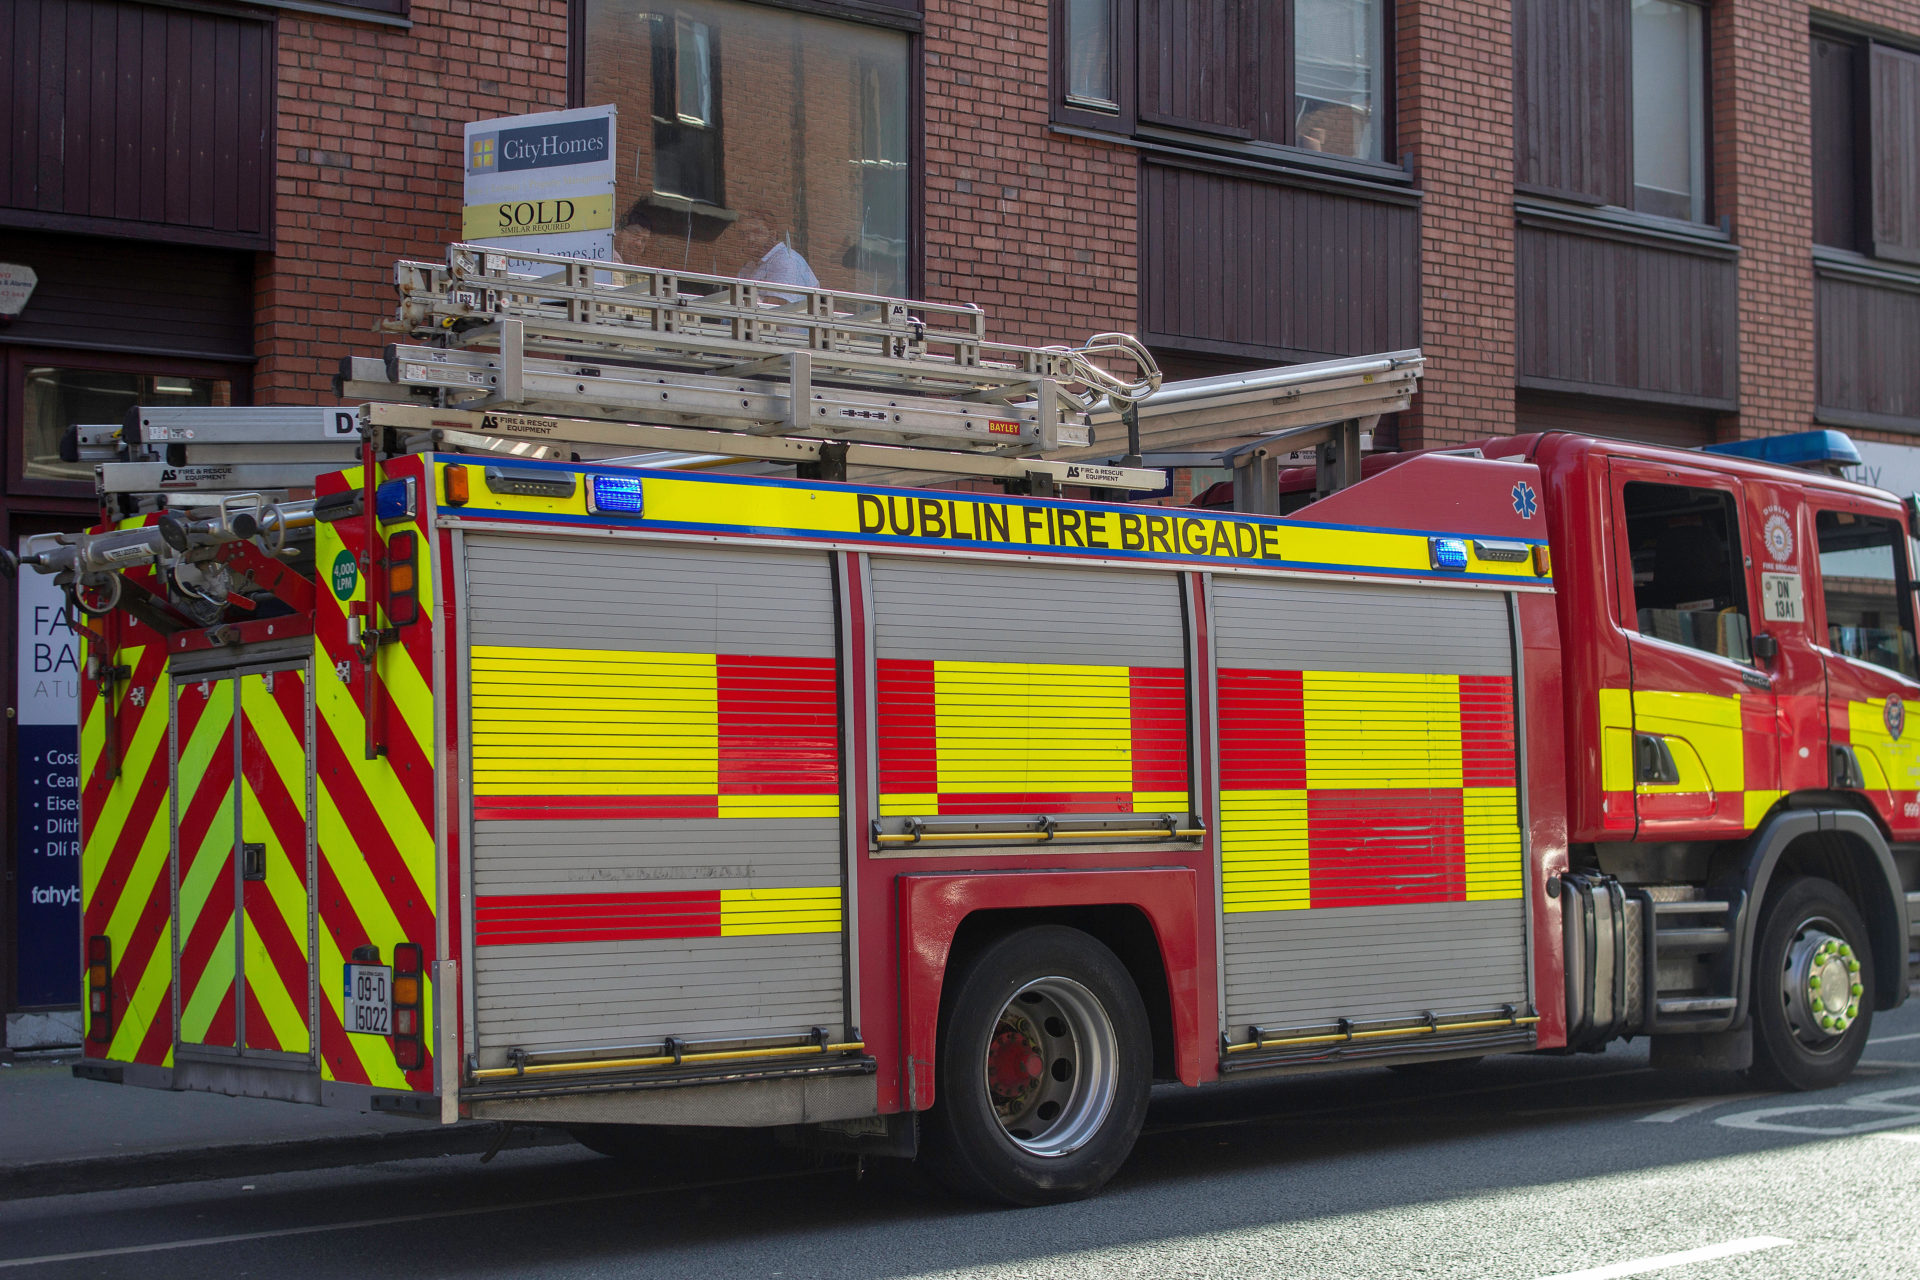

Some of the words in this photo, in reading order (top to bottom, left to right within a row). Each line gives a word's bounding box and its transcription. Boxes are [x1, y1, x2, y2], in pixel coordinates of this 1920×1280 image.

[504, 135, 604, 163] CityHomes
[499, 200, 575, 228] SOLD
[500, 224, 531, 234] SIMILAR
[532, 222, 571, 232] REQUIRED
[507, 242, 605, 271] citymes.ie
[893, 305, 903, 315] AS
[480, 415, 498, 429] AS
[500, 416, 518, 425] FIRE
[527, 419, 558, 428] RESCUE
[507, 425, 551, 434] EQUIPMENT
[989, 422, 1019, 433] BAYLEY
[161, 469, 177, 482] AS
[1067, 466, 1079, 478] AS
[1086, 474, 1118, 482] EQUIPMENT
[1763, 504, 1790, 520] DUBLIN
[856, 493, 1010, 543] DUBLIN
[1023, 506, 1109, 549] FIRE
[1119, 513, 1281, 560] BRIGADE
[334, 562, 355, 577] 4,000
[337, 577, 353, 590] LPM
[1777, 580, 1789, 598] DN
[1775, 600, 1795, 618] 13A1
[35, 606, 80, 636] FA
[47, 841, 67, 857] Dlí
[358, 975, 385, 1002] 09-D
[355, 1005, 388, 1033] 15022
